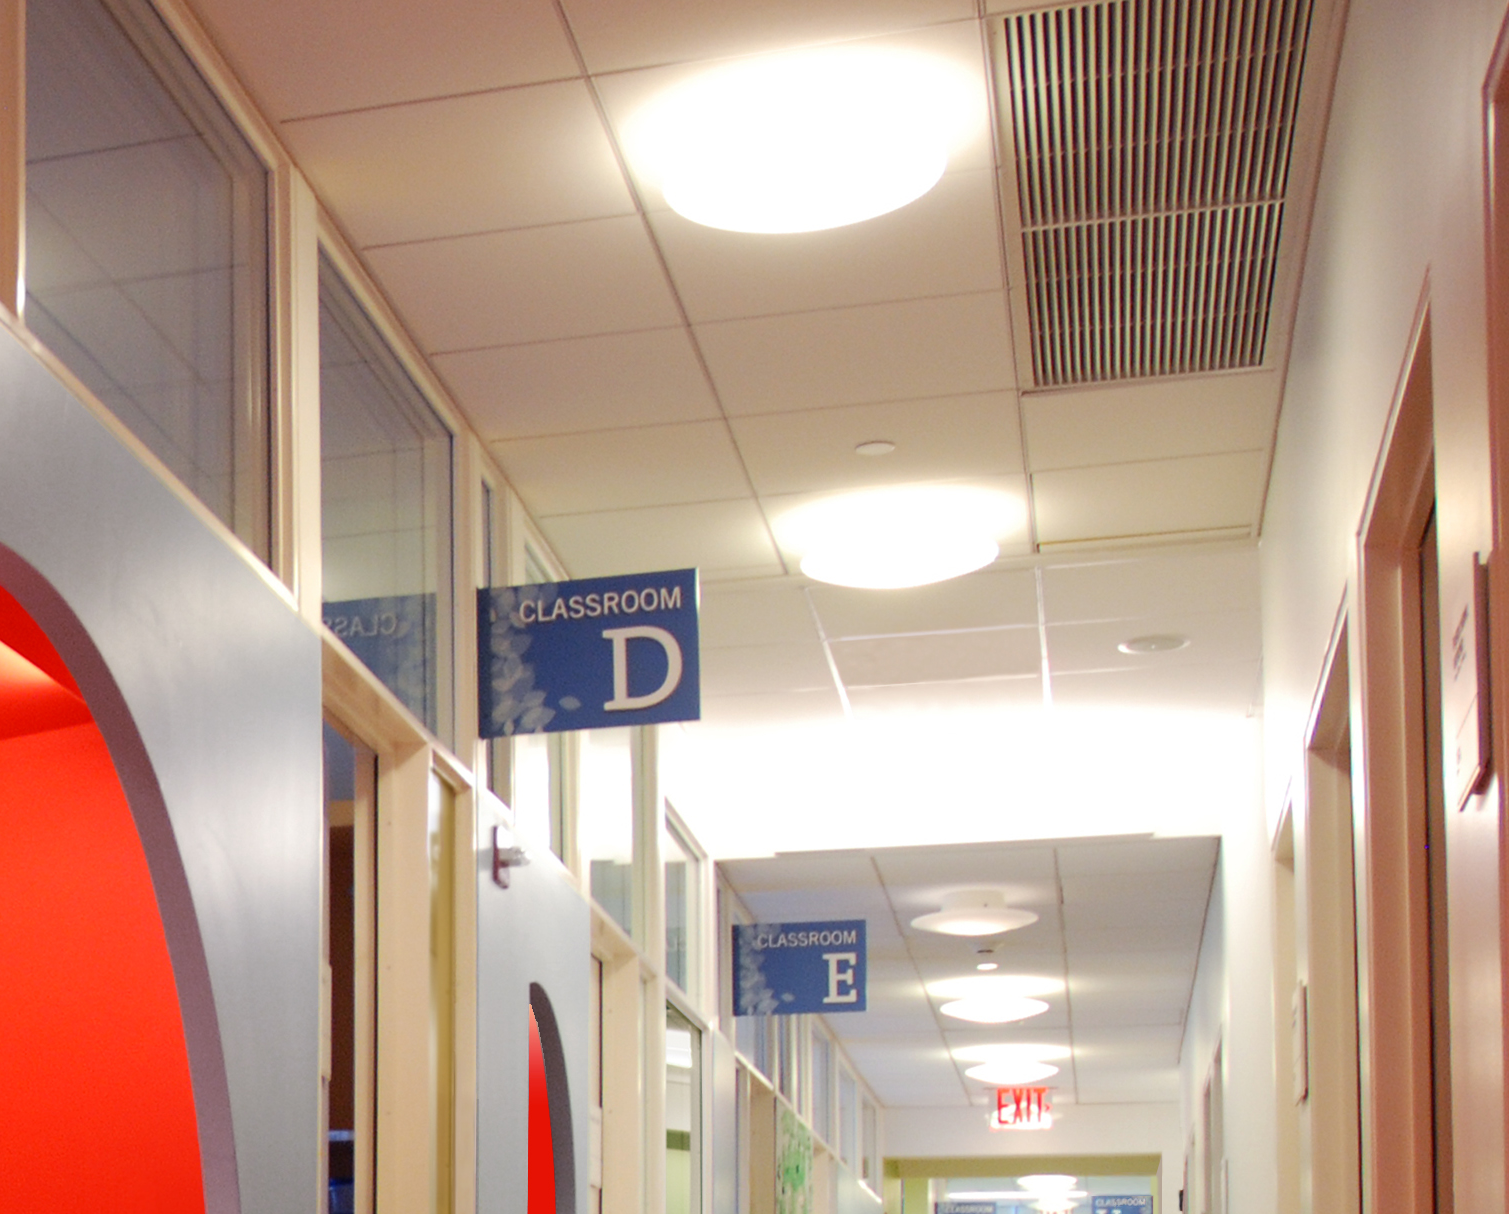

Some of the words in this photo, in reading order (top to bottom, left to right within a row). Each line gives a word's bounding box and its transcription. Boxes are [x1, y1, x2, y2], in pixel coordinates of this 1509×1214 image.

[519, 586, 682, 623] CLASSROOM
[602, 625, 683, 712] D
[756, 930, 857, 948] CLASSROOM
[822, 952, 857, 1004] E
[997, 1087, 1048, 1124] EXIT
